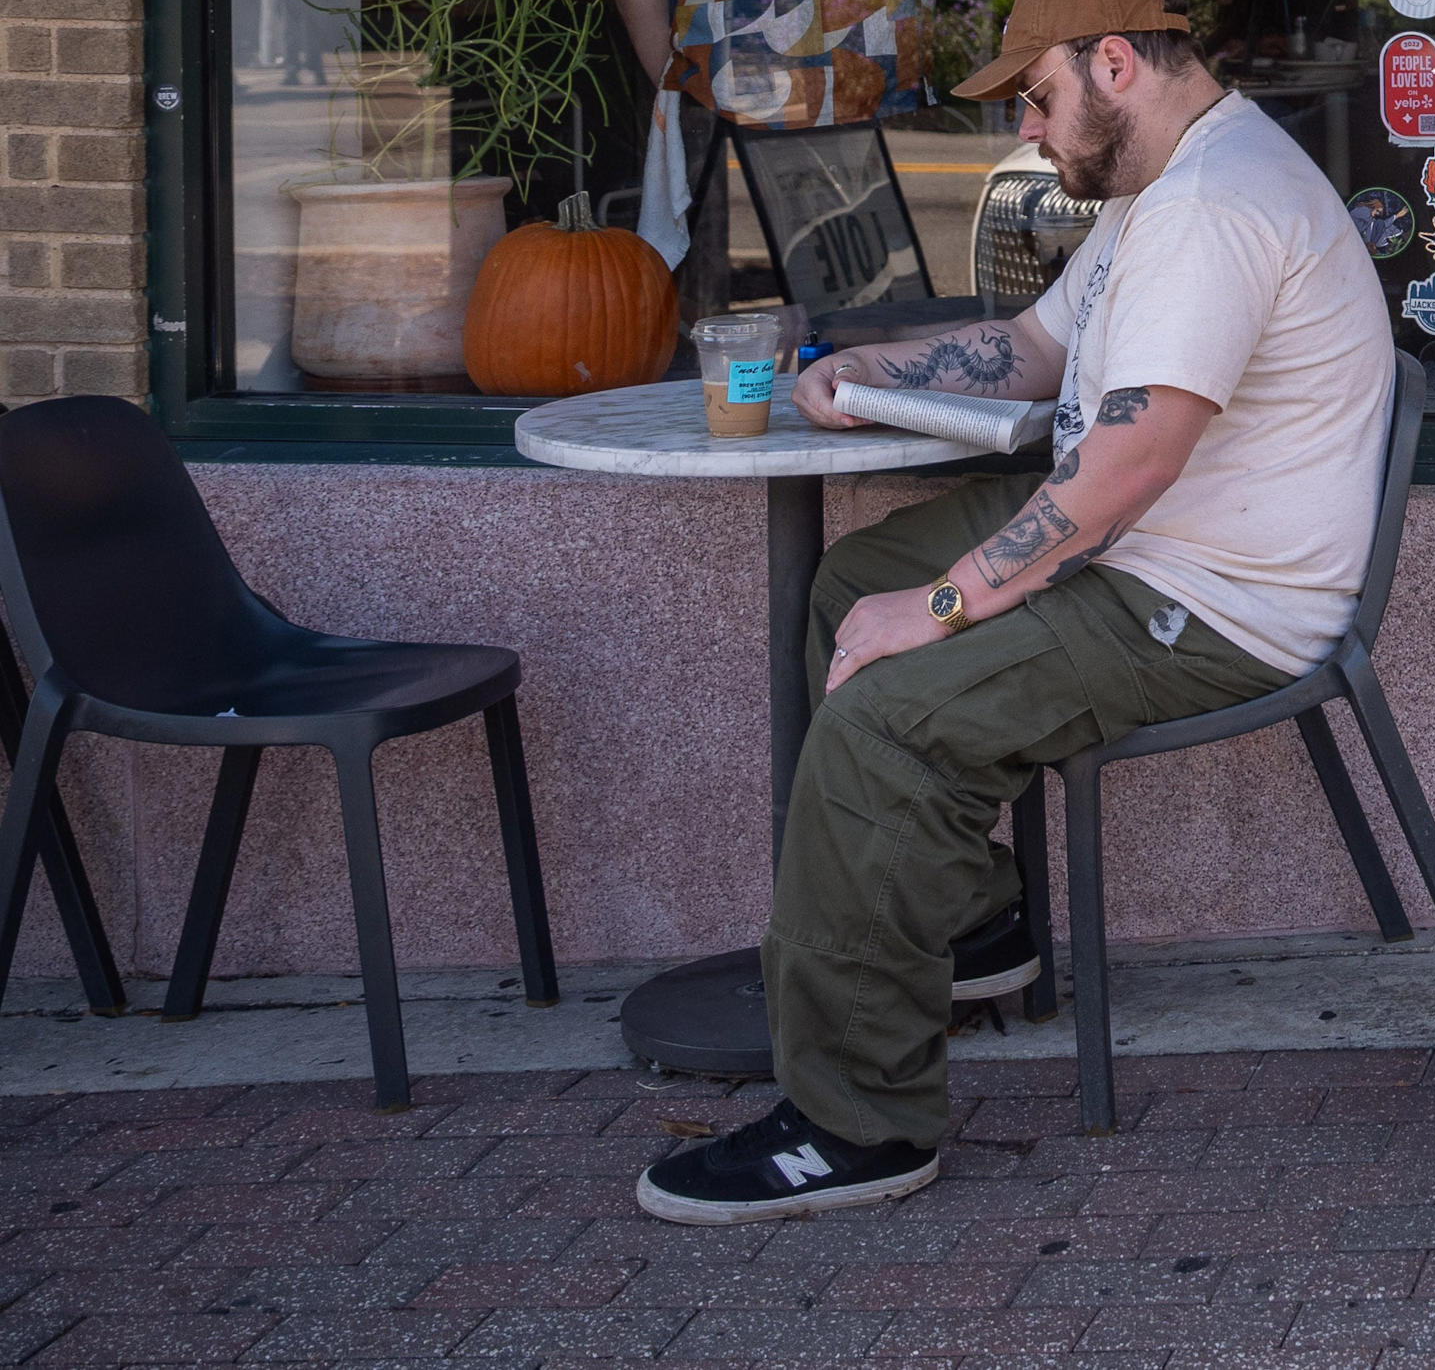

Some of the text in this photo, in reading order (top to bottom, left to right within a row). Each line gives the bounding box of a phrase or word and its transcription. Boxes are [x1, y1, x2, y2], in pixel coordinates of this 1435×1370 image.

[1392, 55, 1432, 71] PEOPLE
[1391, 73, 1434, 88] LOVE US
[1394, 98, 1421, 110] yelp
